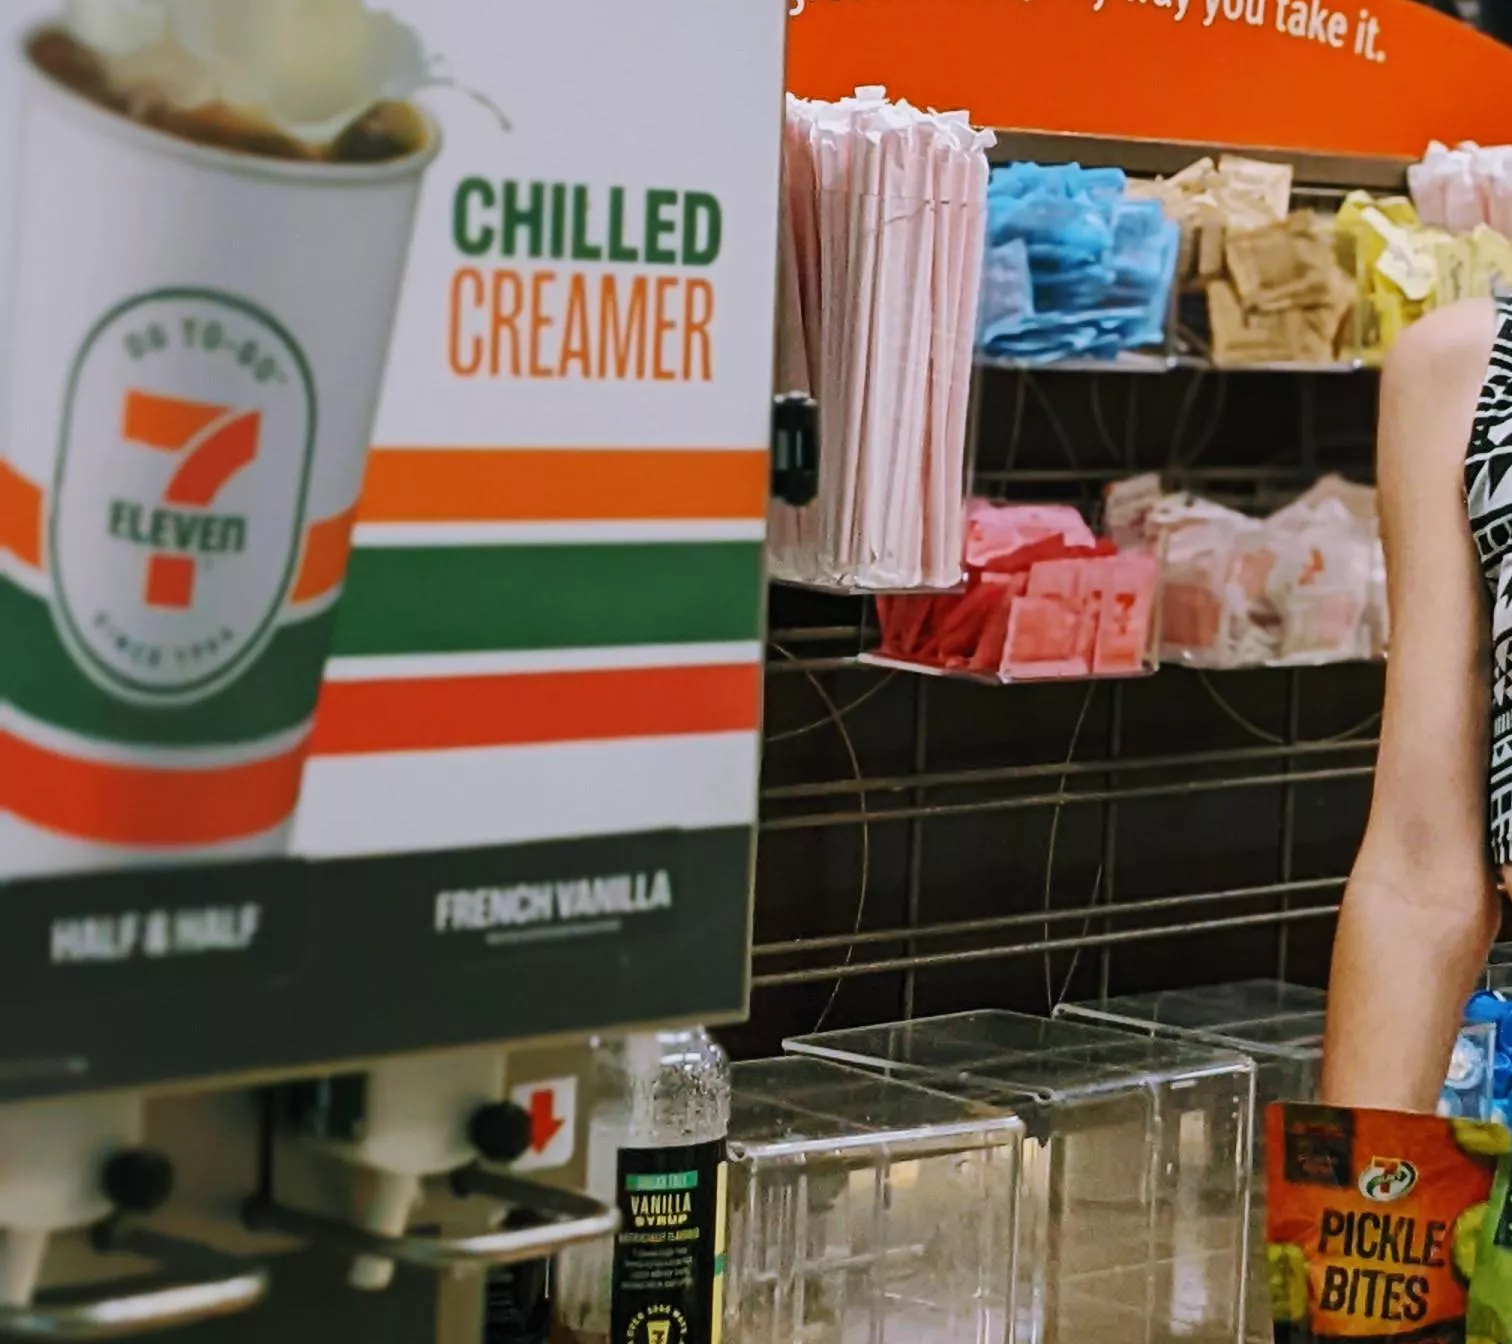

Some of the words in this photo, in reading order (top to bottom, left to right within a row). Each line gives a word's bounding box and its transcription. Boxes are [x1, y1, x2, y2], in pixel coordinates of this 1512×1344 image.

[1354, 8, 1387, 63] it.
[450, 176, 723, 267] CHILLED
[446, 266, 715, 382] CREAMER
[434, 881, 553, 934] FRENCH
[554, 869, 673, 924] VANILLA
[50, 913, 139, 964] HALF
[174, 902, 261, 952] HALF
[630, 1192, 692, 1216] VANILLA
[1316, 1208, 1448, 1268] PICKLE
[1318, 1264, 1430, 1322] BITES
